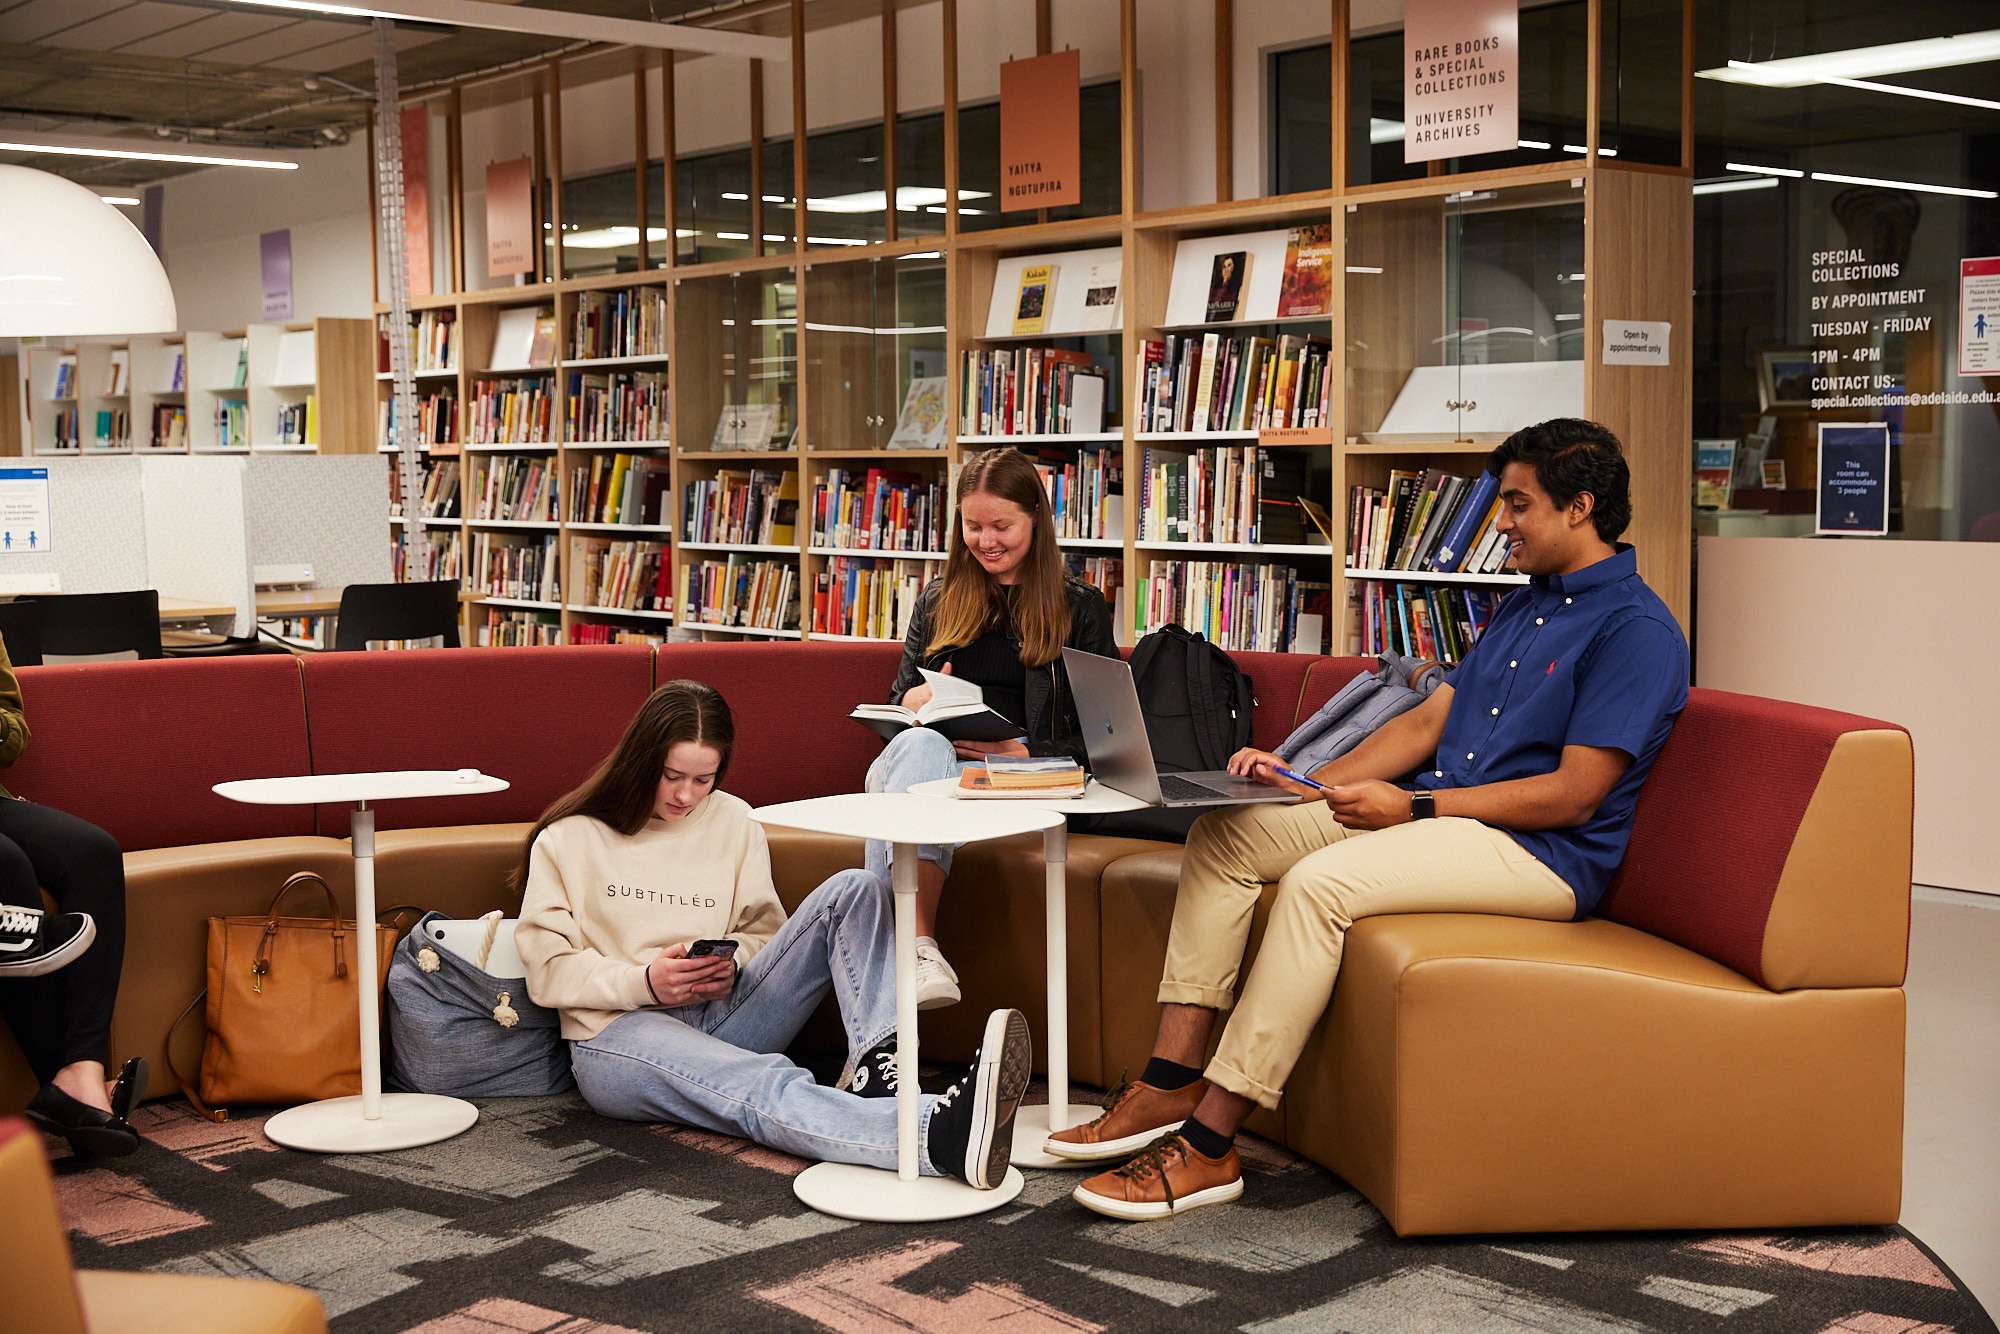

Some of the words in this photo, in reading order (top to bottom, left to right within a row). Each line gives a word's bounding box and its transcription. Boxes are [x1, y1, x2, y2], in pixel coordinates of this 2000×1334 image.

[1415, 45, 1449, 62] RARE
[1455, 36, 1500, 56] BOOKS
[1415, 66, 1423, 80] &
[1429, 56, 1485, 78] SPECIAL
[1415, 70, 1505, 95] COLLECTIONS
[1415, 103, 1495, 127] UNIVERSITY
[1415, 123, 1481, 144] ARCHIVES
[1008, 161, 1043, 177] YAITYA
[1008, 180, 1063, 197] NGUTUPIRA
[1298, 247, 1332, 258] Indigenou
[1811, 249, 1866, 267] SPECIAL
[1296, 257, 1324, 268] Service
[1811, 263, 1899, 282] COLLECTIONS
[1811, 295, 1829, 311] BY
[1832, 288, 1926, 309] APPOINTMENT
[1623, 330, 1640, 340] Open
[1641, 331, 1649, 341] by
[1811, 320, 1869, 338] TUESDAY
[1883, 316, 1932, 333] FRIDAY
[1609, 343, 1648, 353] appointment
[1648, 344, 1661, 355] only
[1811, 349, 1838, 364] 1PM
[1852, 347, 1881, 362] 4PM
[1811, 375, 1870, 391] CONTACT
[1873, 375, 1896, 389] US:
[1845, 460, 1860, 469] This
[1828, 478, 1878, 486] accommodate
[1843, 486, 1868, 496] people
[607, 884, 716, 908] SUBTITLÉD
